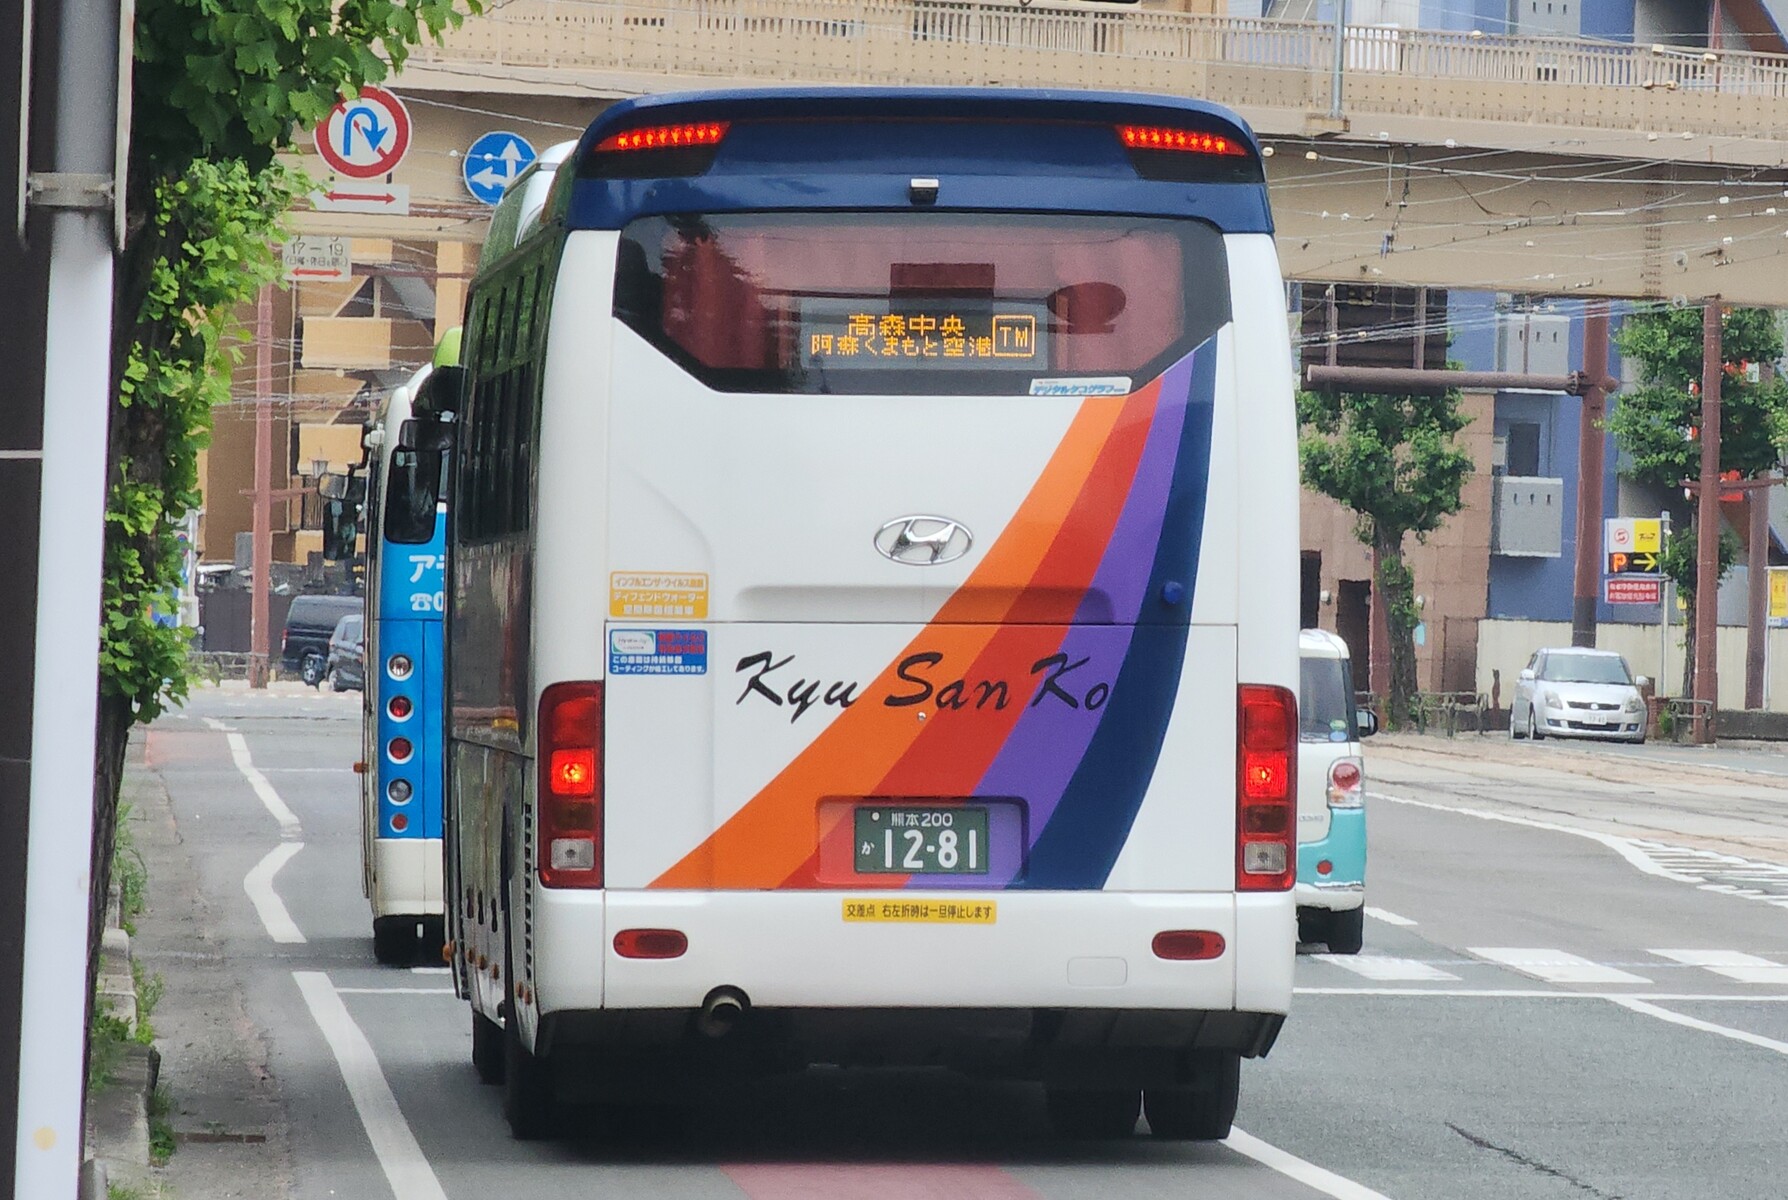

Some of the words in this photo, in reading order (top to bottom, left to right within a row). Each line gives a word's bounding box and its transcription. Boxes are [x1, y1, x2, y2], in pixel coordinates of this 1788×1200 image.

[848, 313, 965, 336] 高森中央
[811, 334, 991, 357] 阿蘇くまもと空港
[999, 326, 1028, 348] TM
[1612, 553, 1627, 573] P
[735, 651, 858, 724] Kyu
[883, 652, 1011, 710] San
[1030, 653, 1109, 711] Ko
[861, 841, 875, 855] か
[884, 829, 977, 869] 12-81
[847, 904, 876, 917] 交差点
[882, 904, 992, 919] 右左折時は一旦停止します
